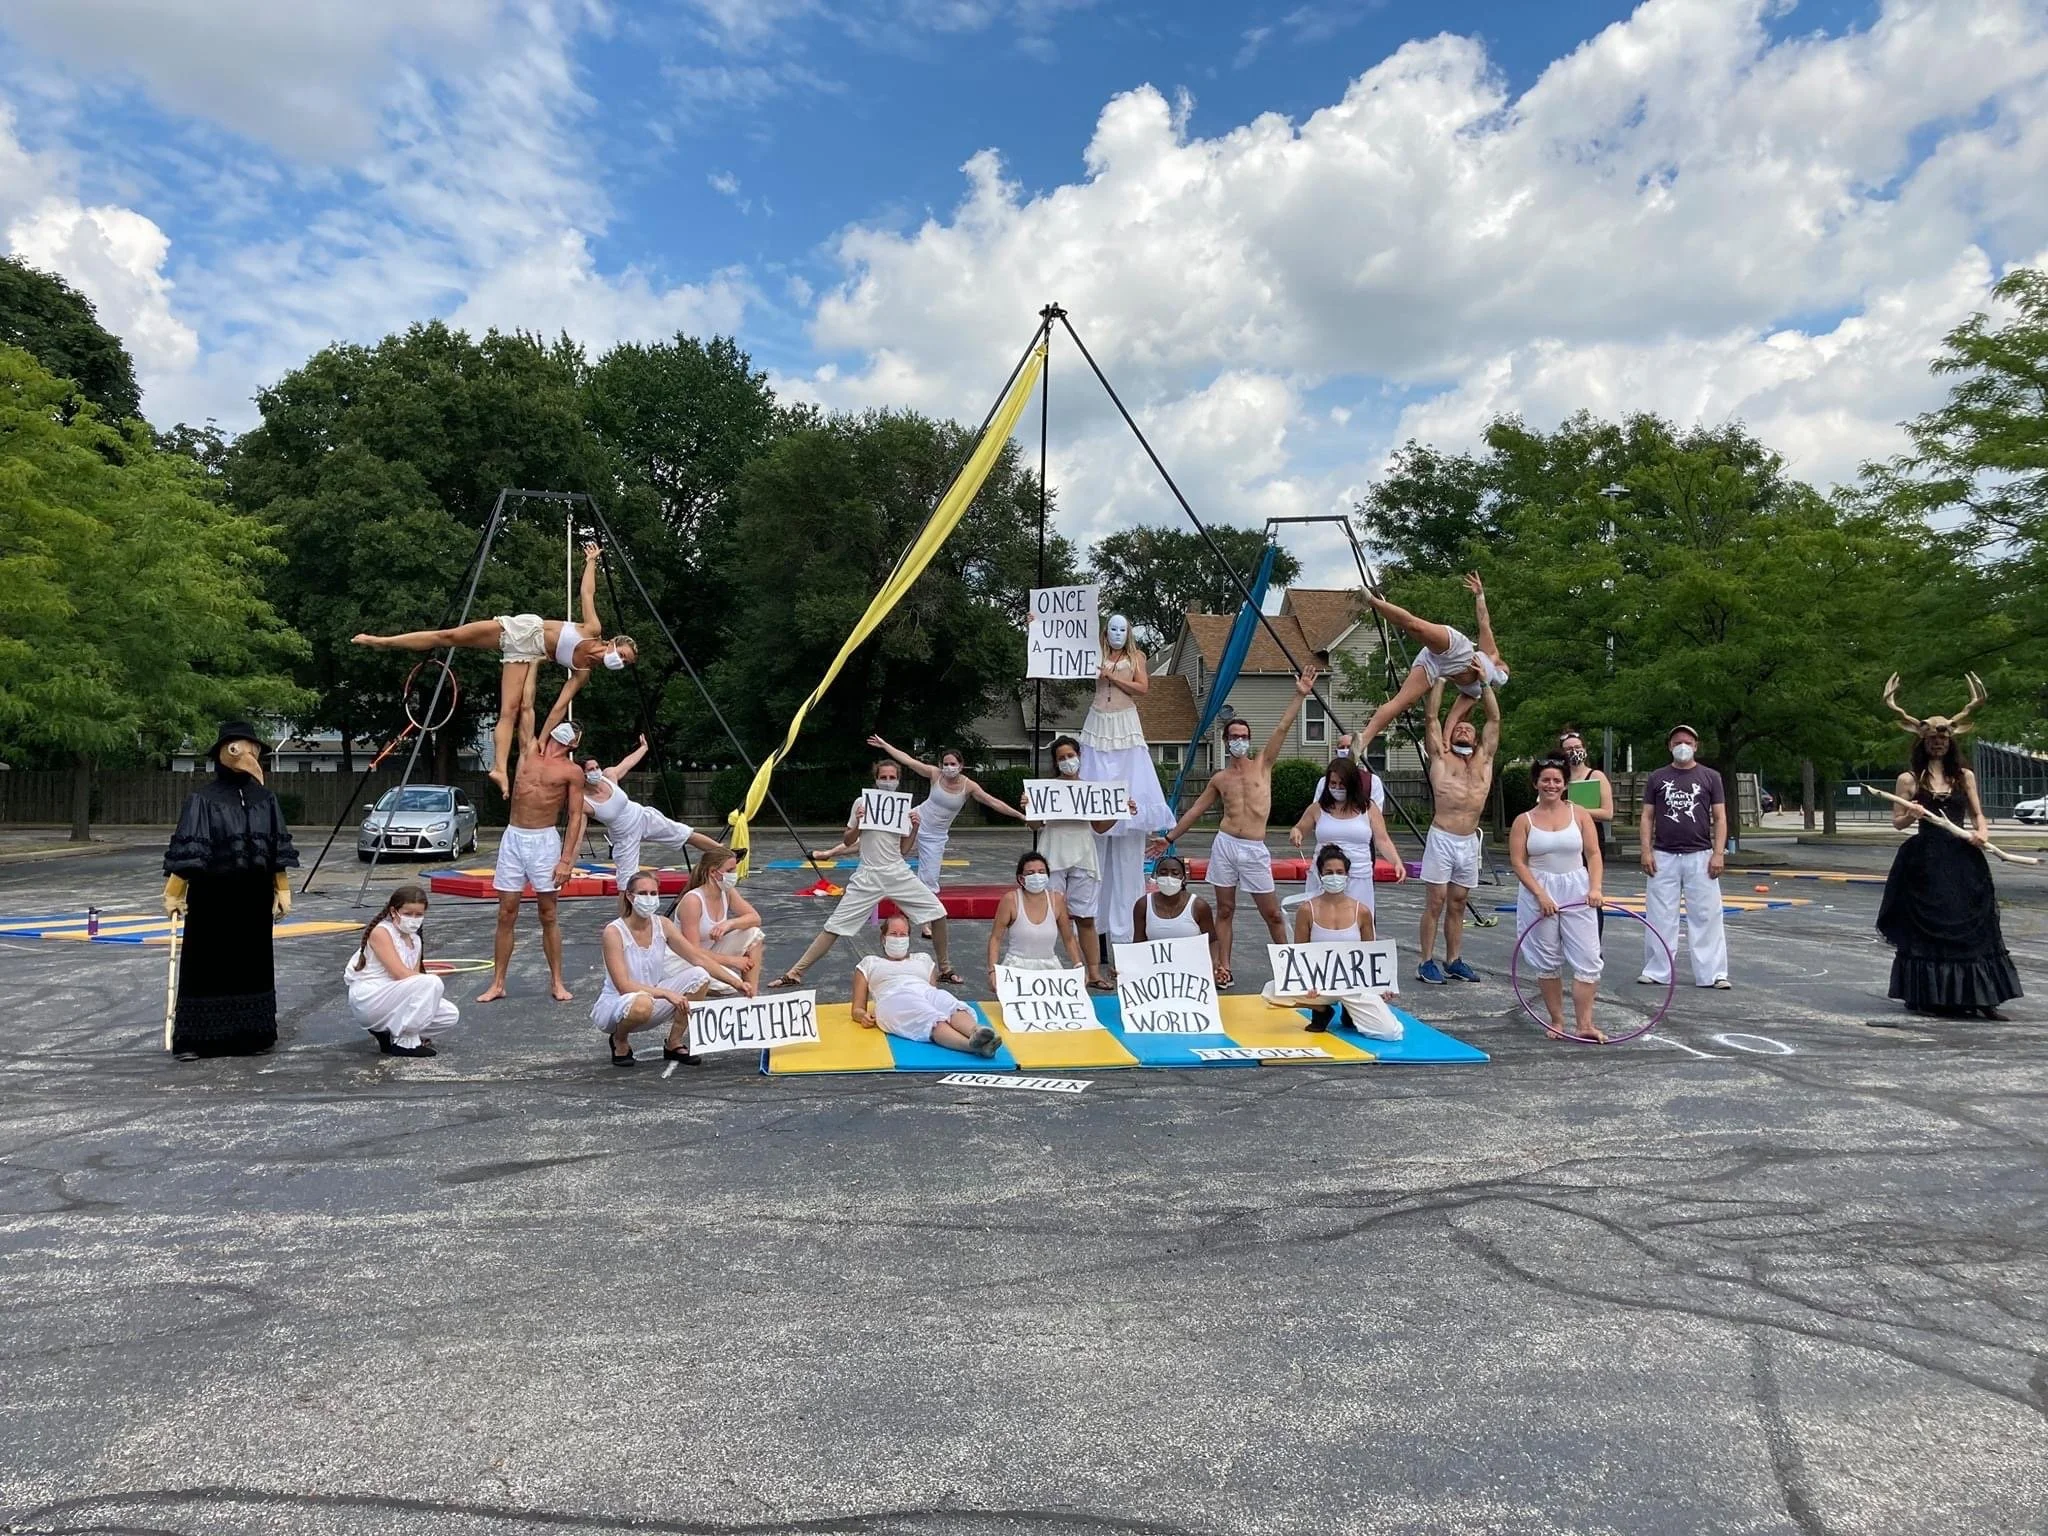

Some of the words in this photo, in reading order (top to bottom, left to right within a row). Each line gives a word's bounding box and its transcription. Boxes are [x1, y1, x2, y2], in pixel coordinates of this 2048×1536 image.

[1037, 590, 1086, 614] ONCE
[1042, 619, 1087, 639] UPON
[1032, 640, 1042, 653] A
[863, 793, 909, 828] NOT
[1028, 786, 1062, 814] WE
[1067, 785, 1127, 814] WERE
[1150, 942, 1174, 964] IN
[1278, 946, 1391, 991] AWARE
[1004, 968, 1014, 983] A
[1015, 976, 1078, 998] LONG
[1119, 972, 1210, 1009] ANOTHER
[691, 999, 816, 1046] TOGETHER
[1006, 1000, 1087, 1021] TIME
[1023, 1021, 1083, 1033] AGO
[949, 1074, 1086, 1090] TOGETHER
